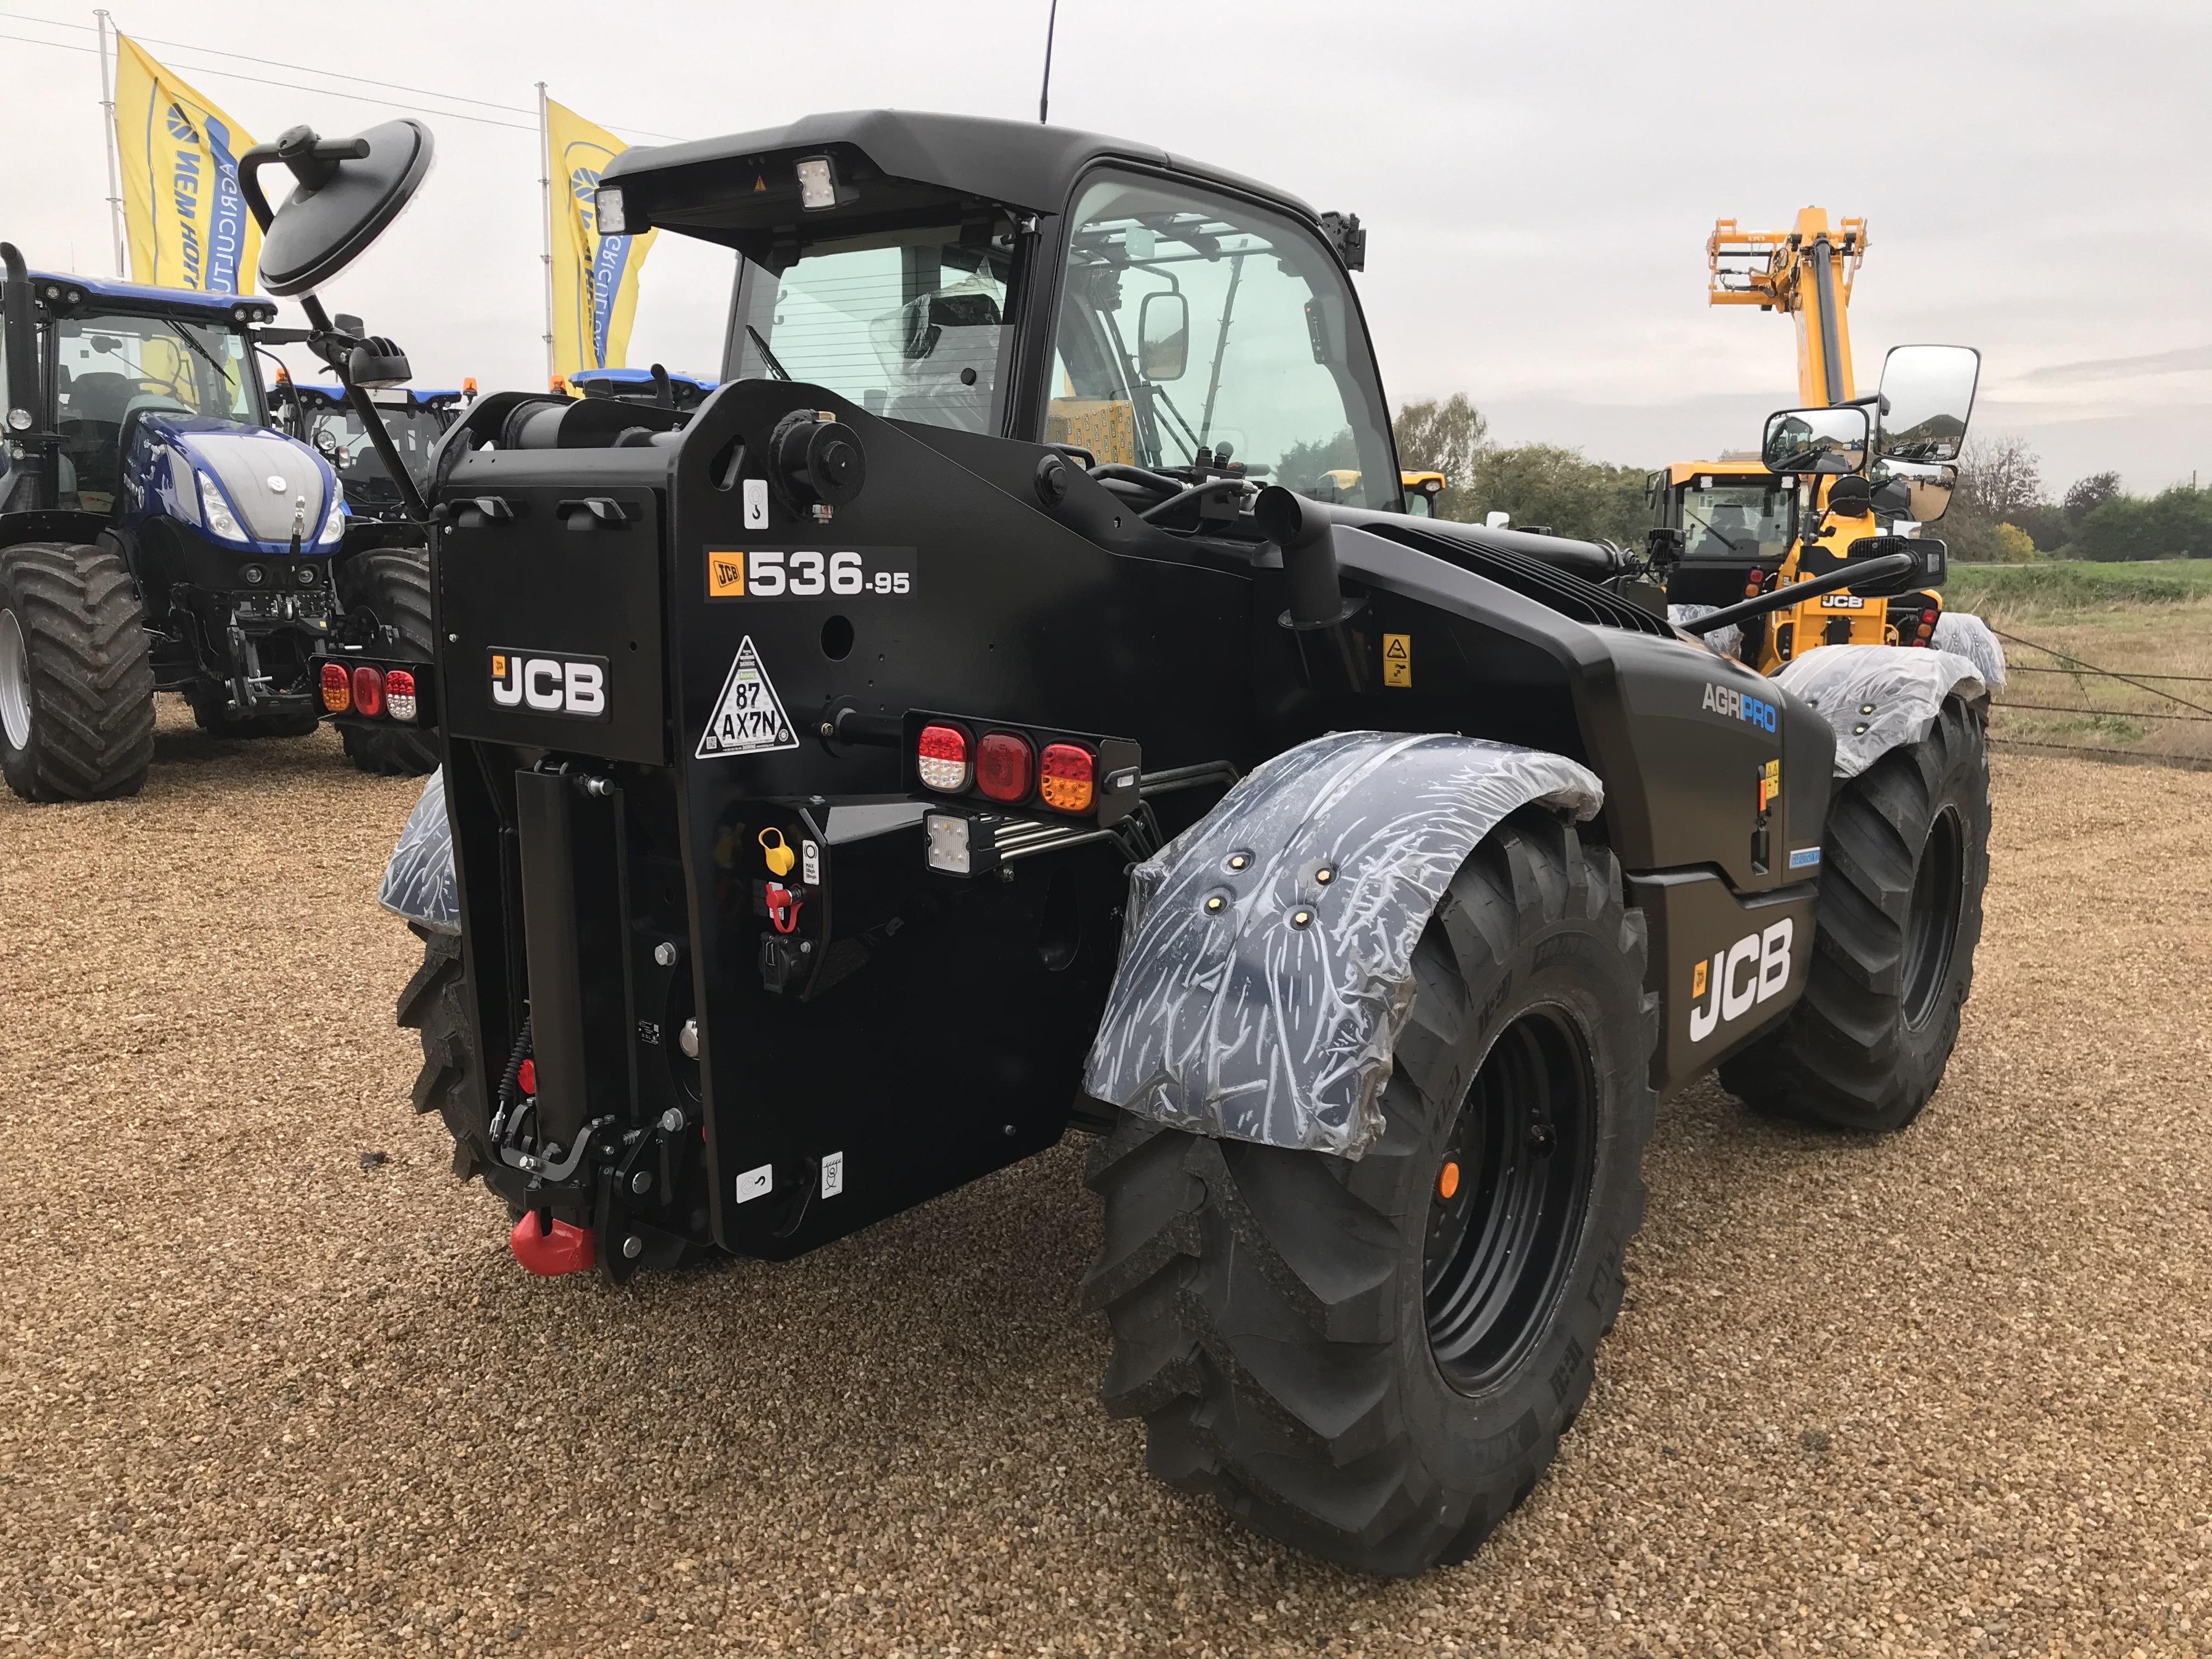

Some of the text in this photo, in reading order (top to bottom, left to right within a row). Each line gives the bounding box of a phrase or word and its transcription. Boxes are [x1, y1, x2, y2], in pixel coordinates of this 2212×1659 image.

[719, 564, 738, 585] JCB
[1822, 595, 1863, 608] JCB
[493, 656, 605, 714] JCB
[736, 682, 760, 710] 87
[722, 710, 776, 741] AX7N
[1690, 917, 1793, 1042] JCB
